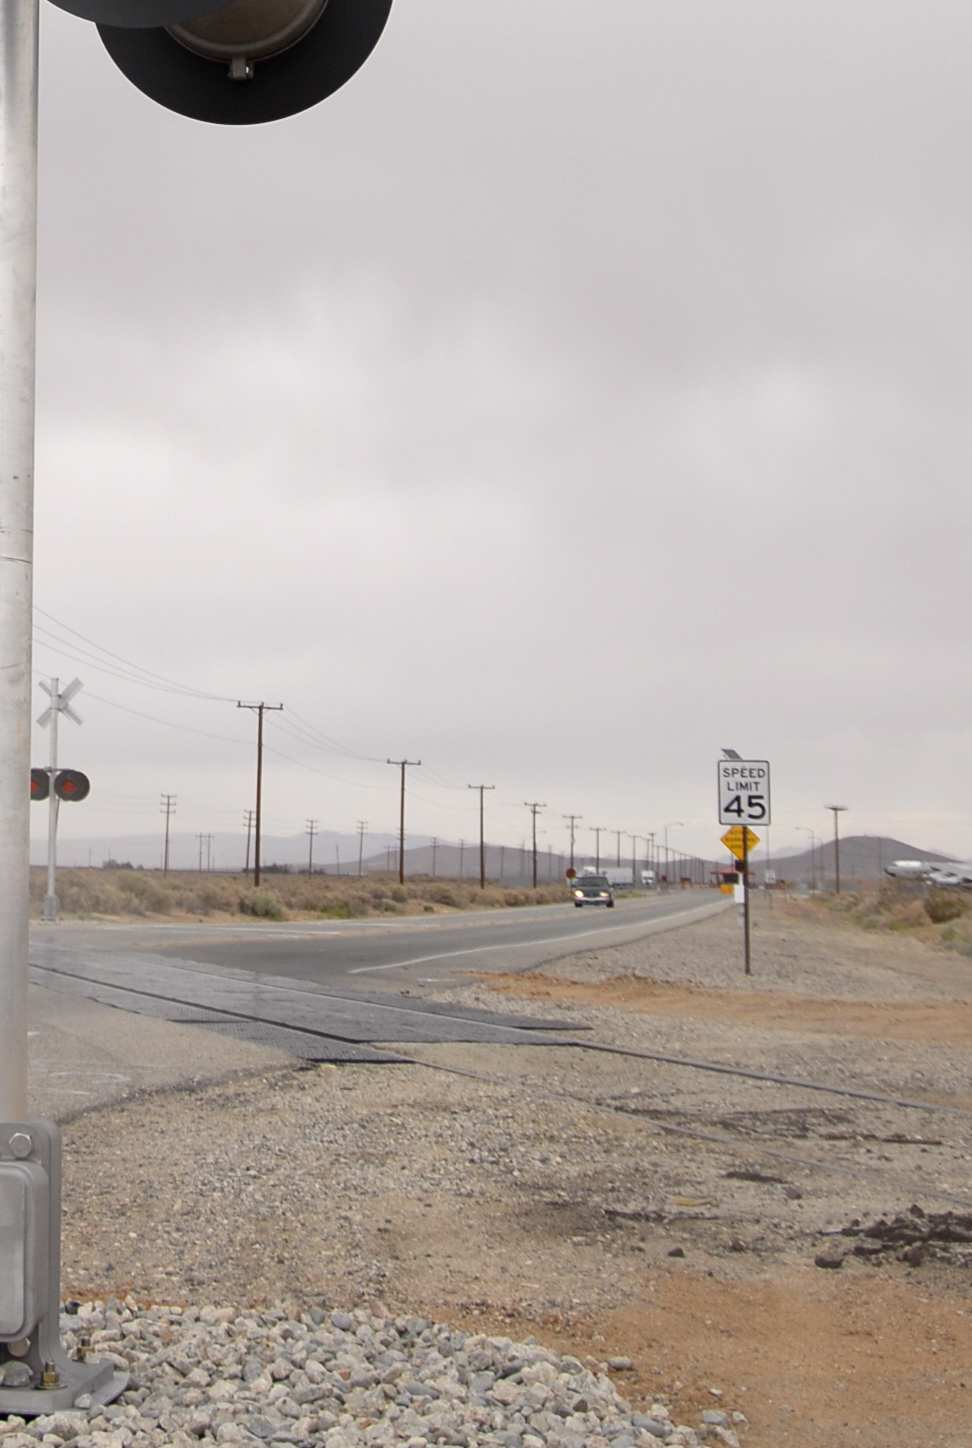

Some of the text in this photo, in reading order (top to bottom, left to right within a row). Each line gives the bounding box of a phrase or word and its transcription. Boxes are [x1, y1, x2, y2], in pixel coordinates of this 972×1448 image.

[723, 767, 766, 778] SPEED
[727, 781, 760, 792] LIMIT
[723, 794, 766, 820] 45
